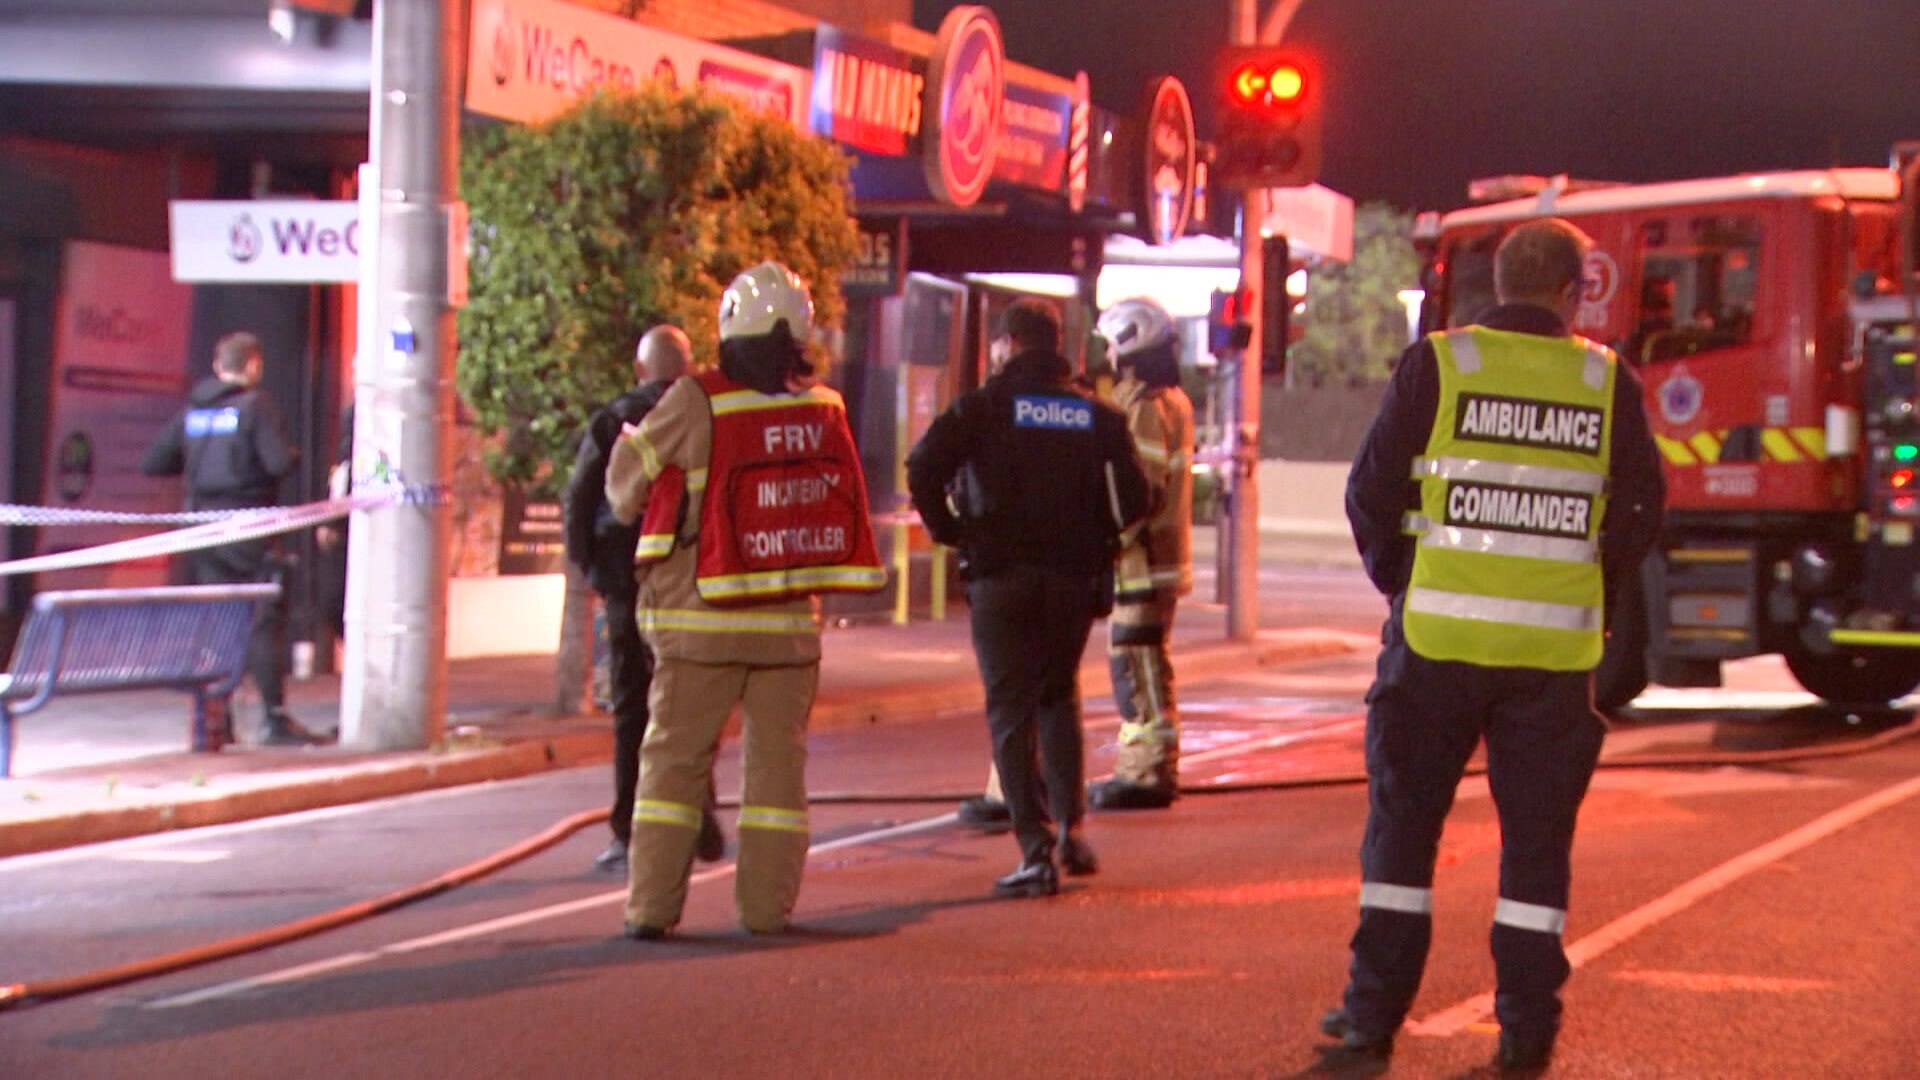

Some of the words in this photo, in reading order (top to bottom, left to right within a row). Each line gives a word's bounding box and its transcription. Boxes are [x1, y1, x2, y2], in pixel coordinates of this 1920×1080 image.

[1015, 399, 1089, 427] Police
[1461, 398, 1601, 448] AMBULANCE
[764, 423, 823, 454] FRV
[1448, 484, 1590, 534] COMMANDER
[743, 525, 846, 557] CONTROLLER
